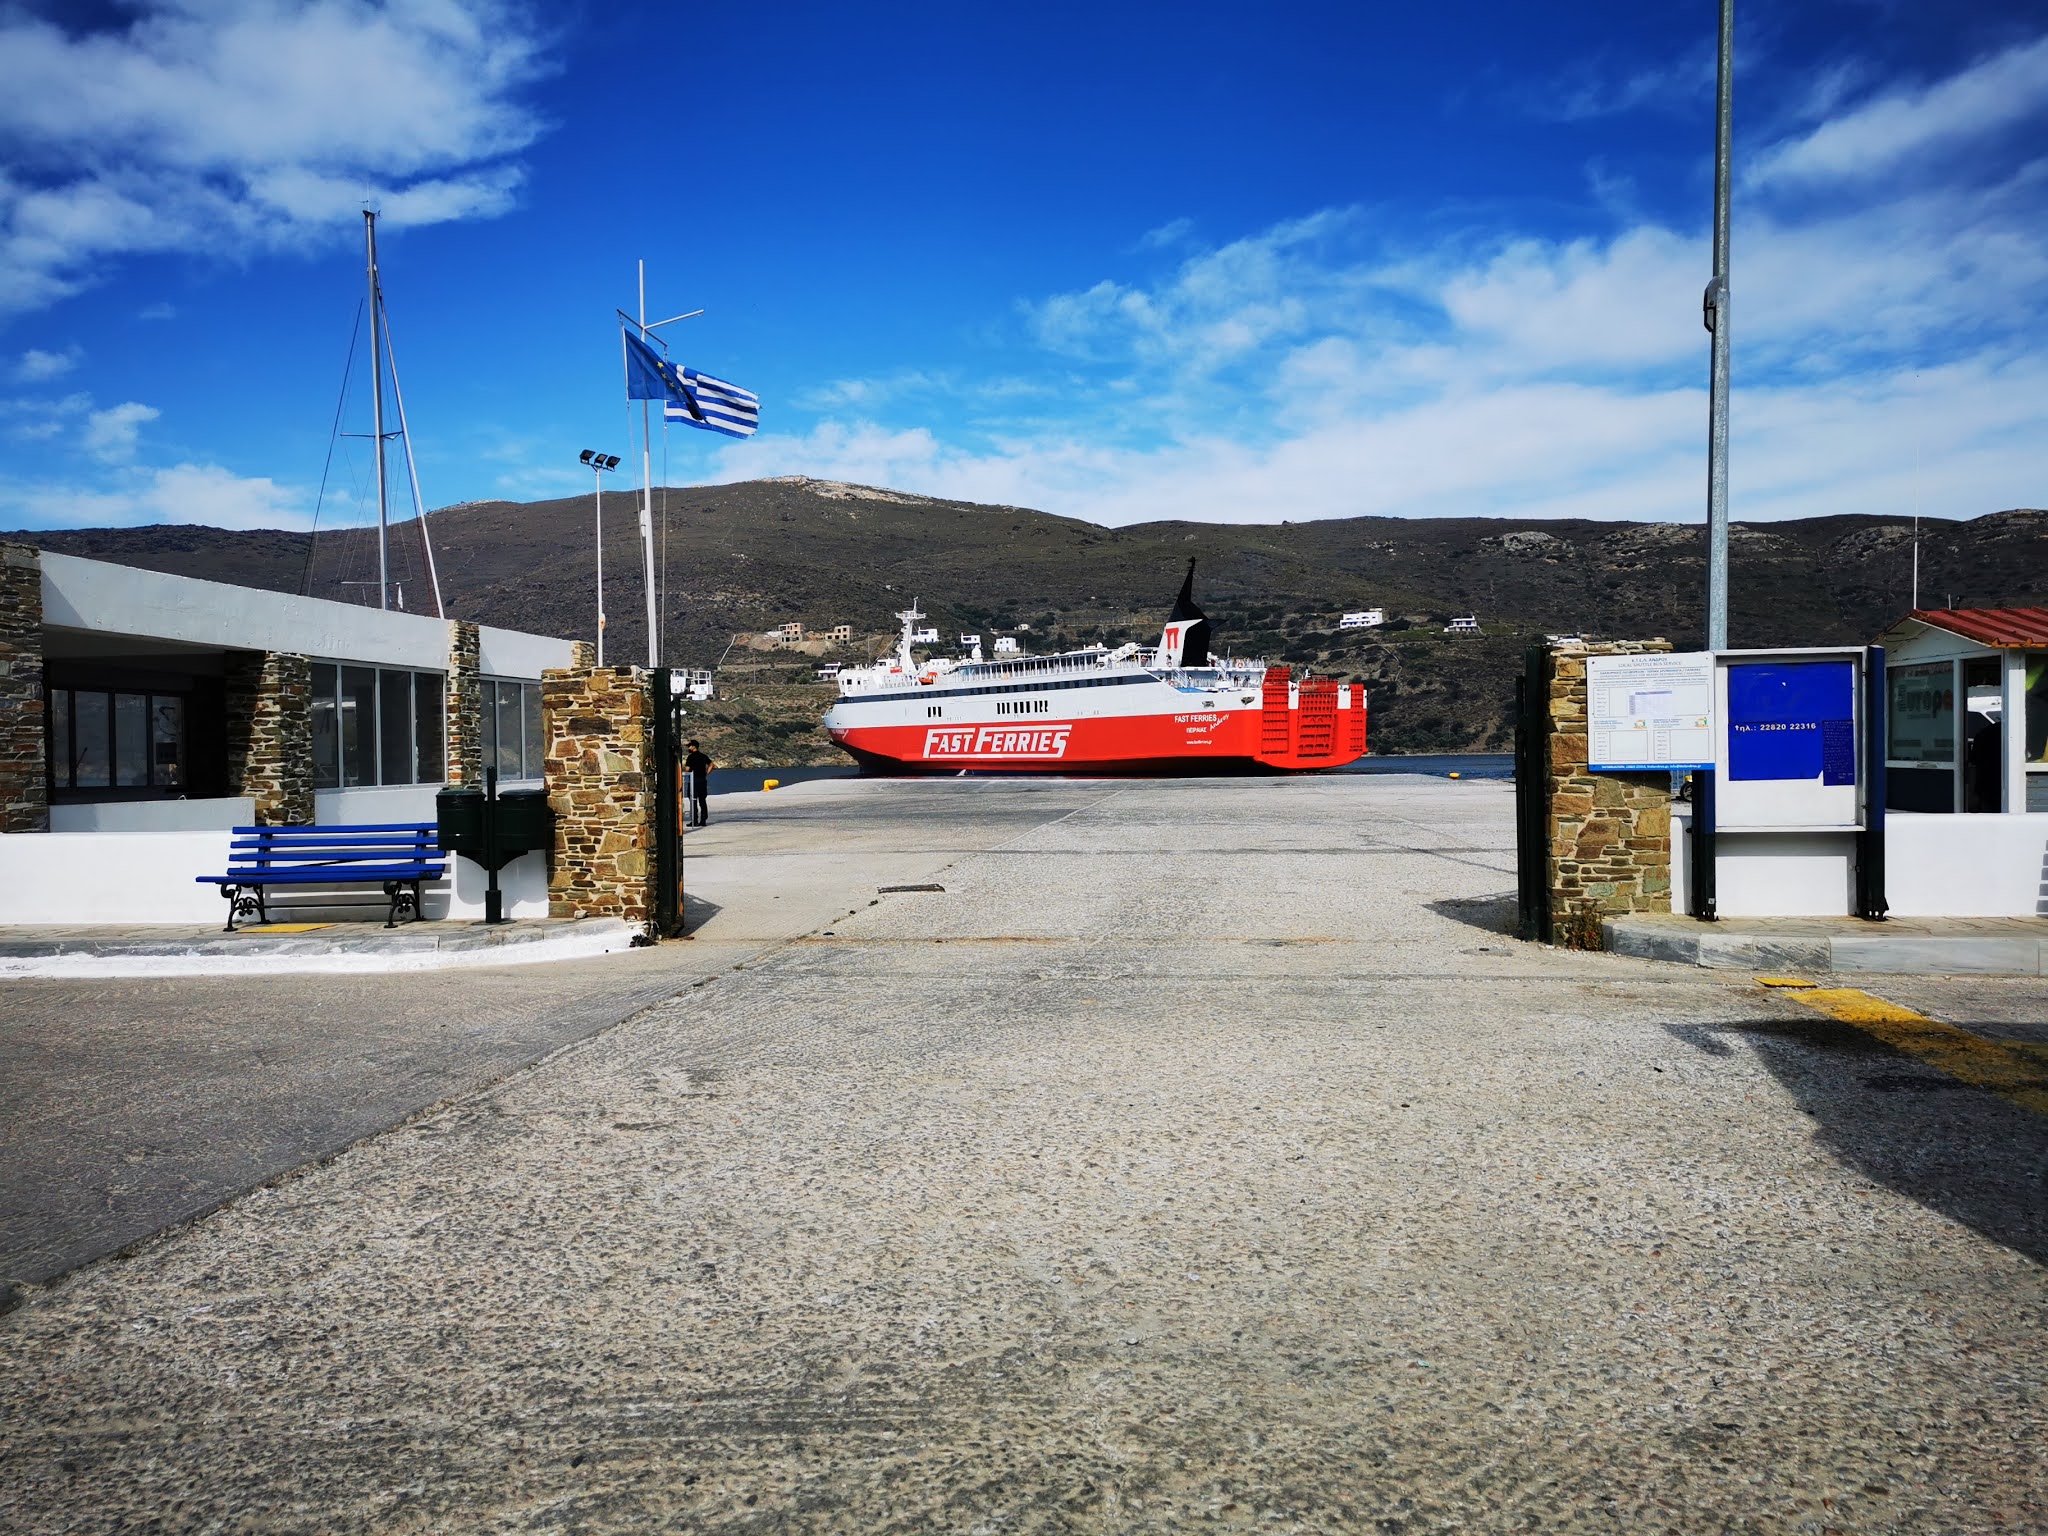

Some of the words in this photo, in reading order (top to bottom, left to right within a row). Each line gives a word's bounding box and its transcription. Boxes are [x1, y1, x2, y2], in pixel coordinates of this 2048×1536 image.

[1174, 715, 1189, 723] FAST
[1190, 714, 1217, 722] FERRIES
[1789, 722, 1817, 730] 22316
[923, 728, 976, 758] FAST
[974, 724, 1073, 758] FERRIES
